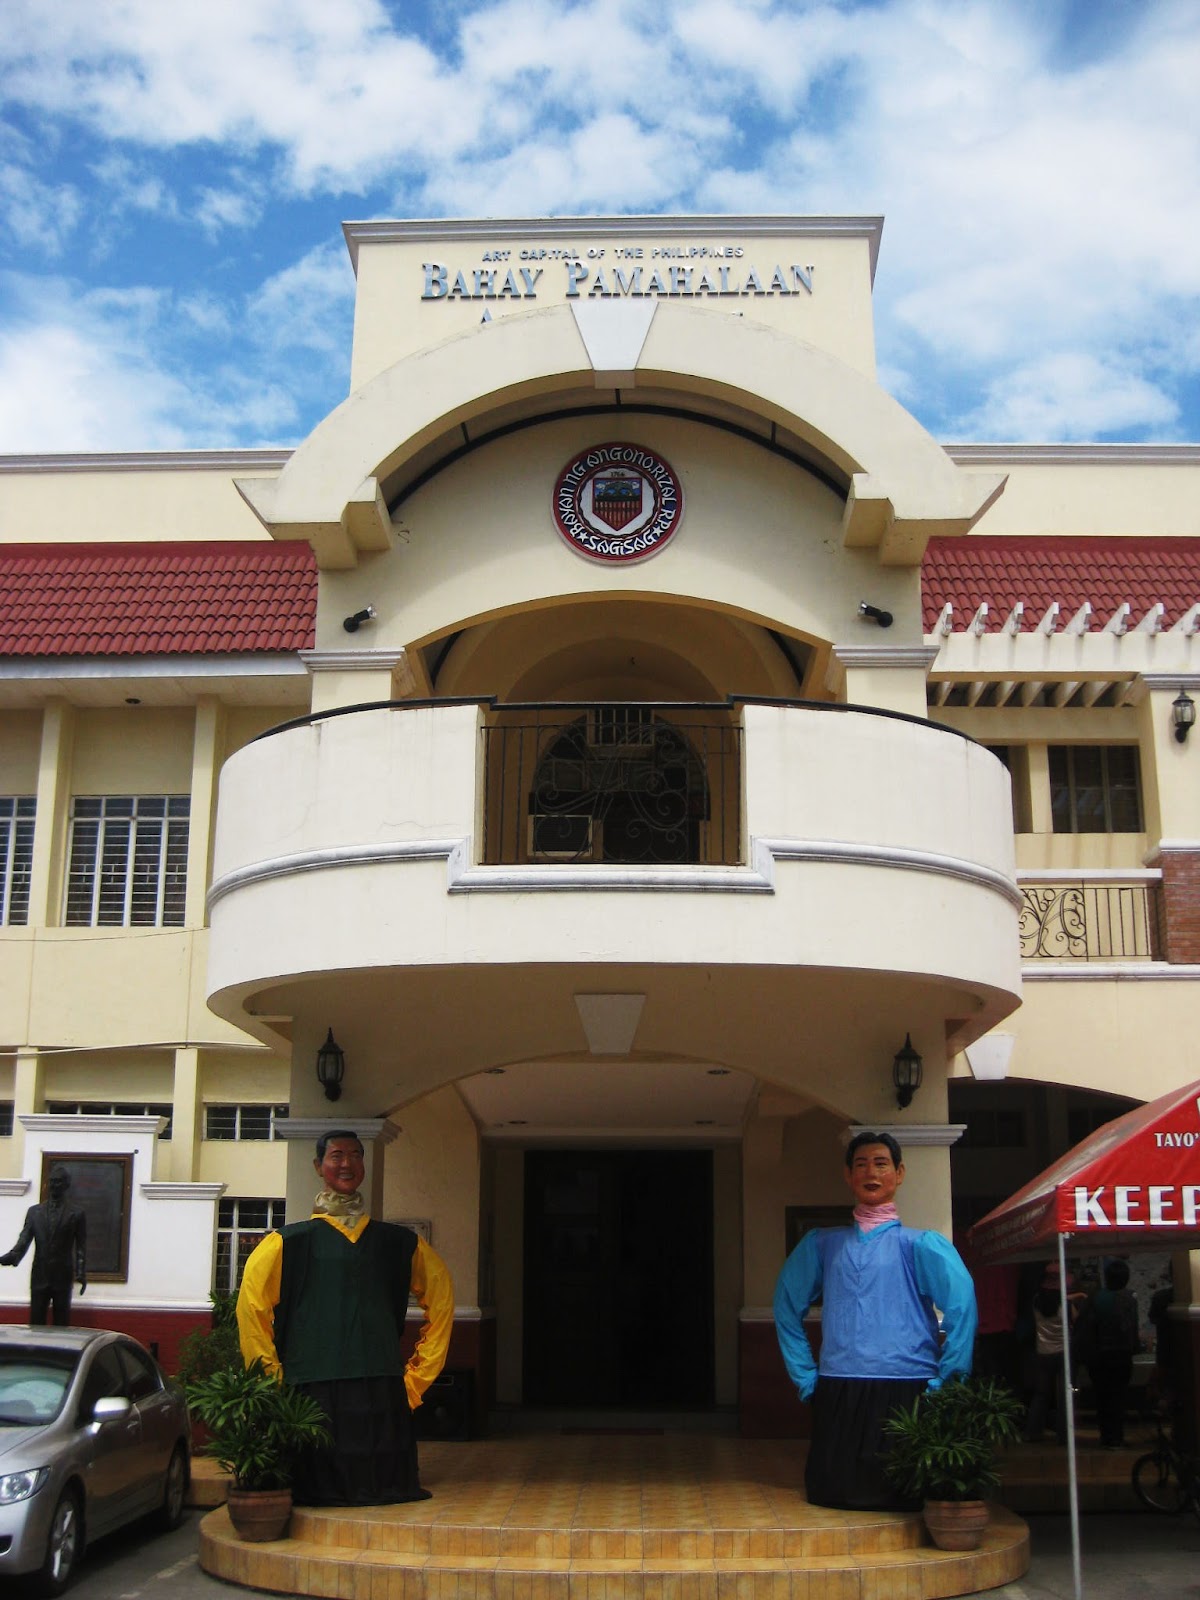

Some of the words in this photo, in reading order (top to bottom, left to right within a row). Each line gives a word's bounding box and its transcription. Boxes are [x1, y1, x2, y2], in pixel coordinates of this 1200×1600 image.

[482, 250, 511, 262] ART
[519, 248, 580, 260] CAPITAL
[587, 247, 606, 259] OF
[614, 247, 644, 259] THE
[652, 246, 745, 259] PHILIPPINES
[1154, 1131, 1200, 1148] TAYO'
